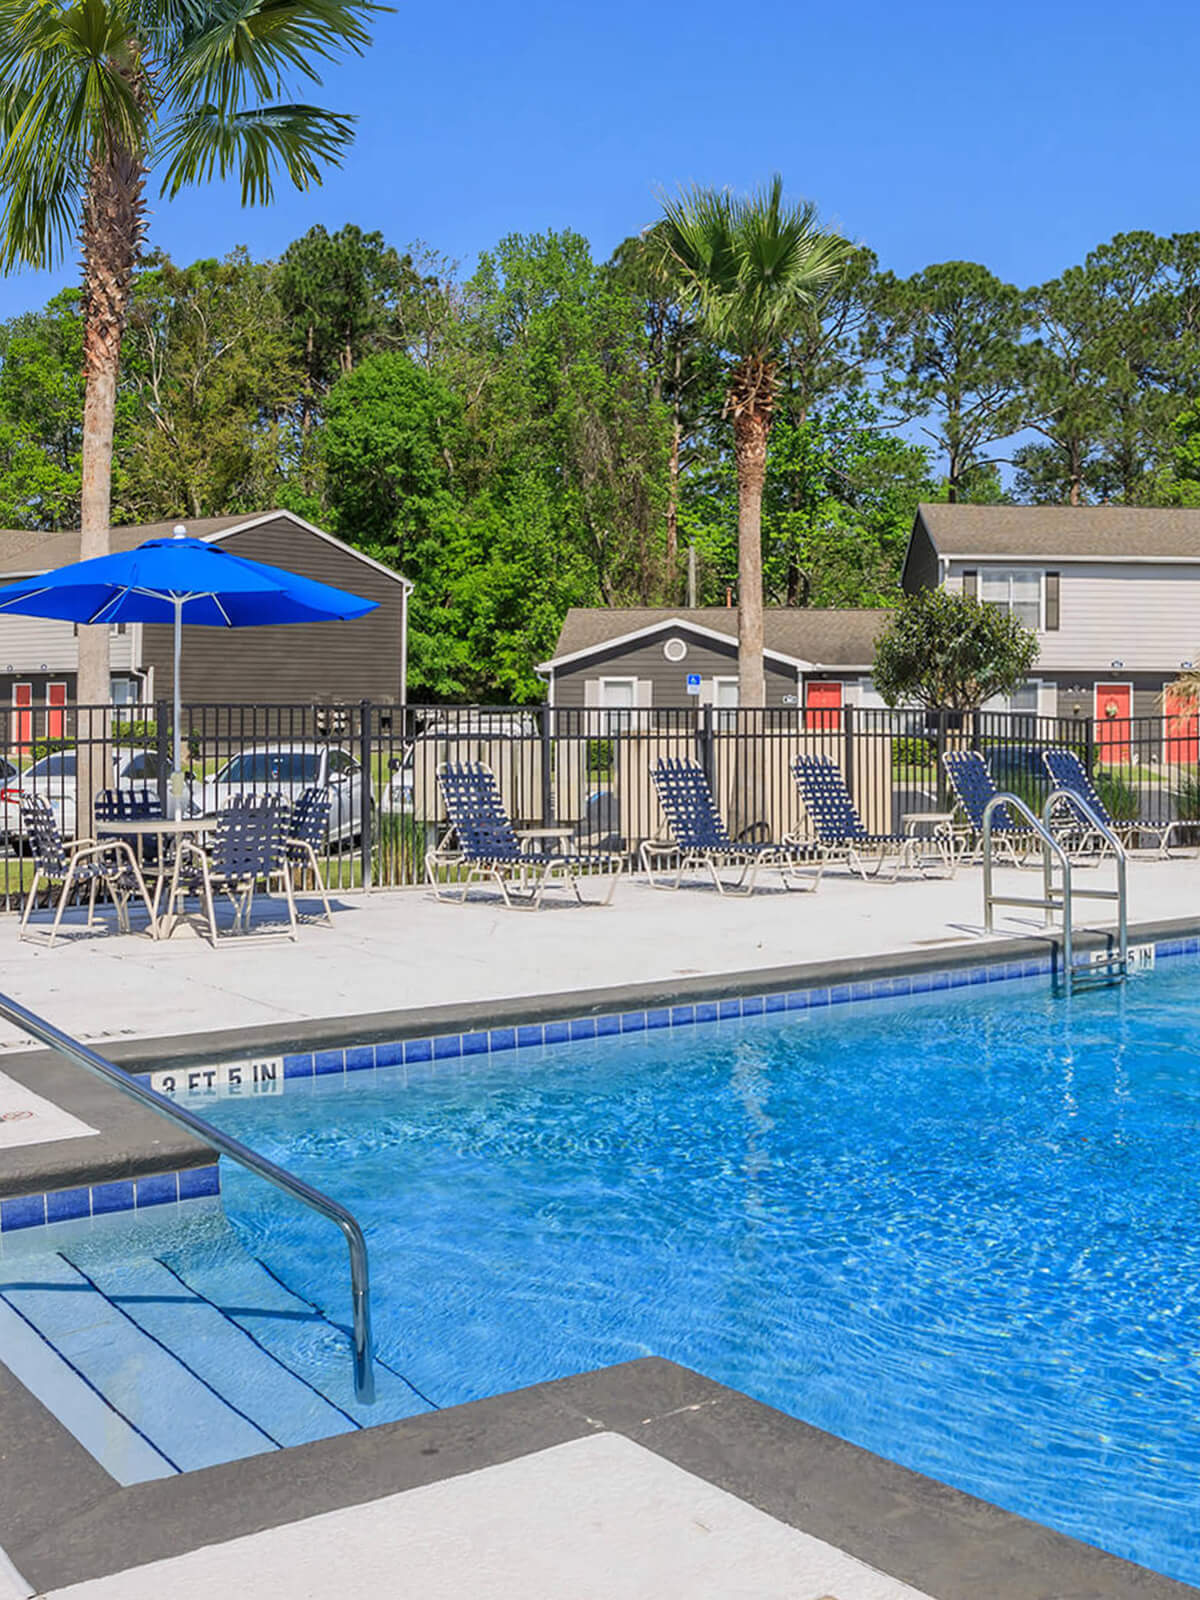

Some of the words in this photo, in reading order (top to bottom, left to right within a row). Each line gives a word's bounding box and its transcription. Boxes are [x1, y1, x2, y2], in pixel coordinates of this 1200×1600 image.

[188, 1070, 216, 1090] FT
[228, 1067, 242, 1085] 5
[253, 1062, 276, 1082] IN
